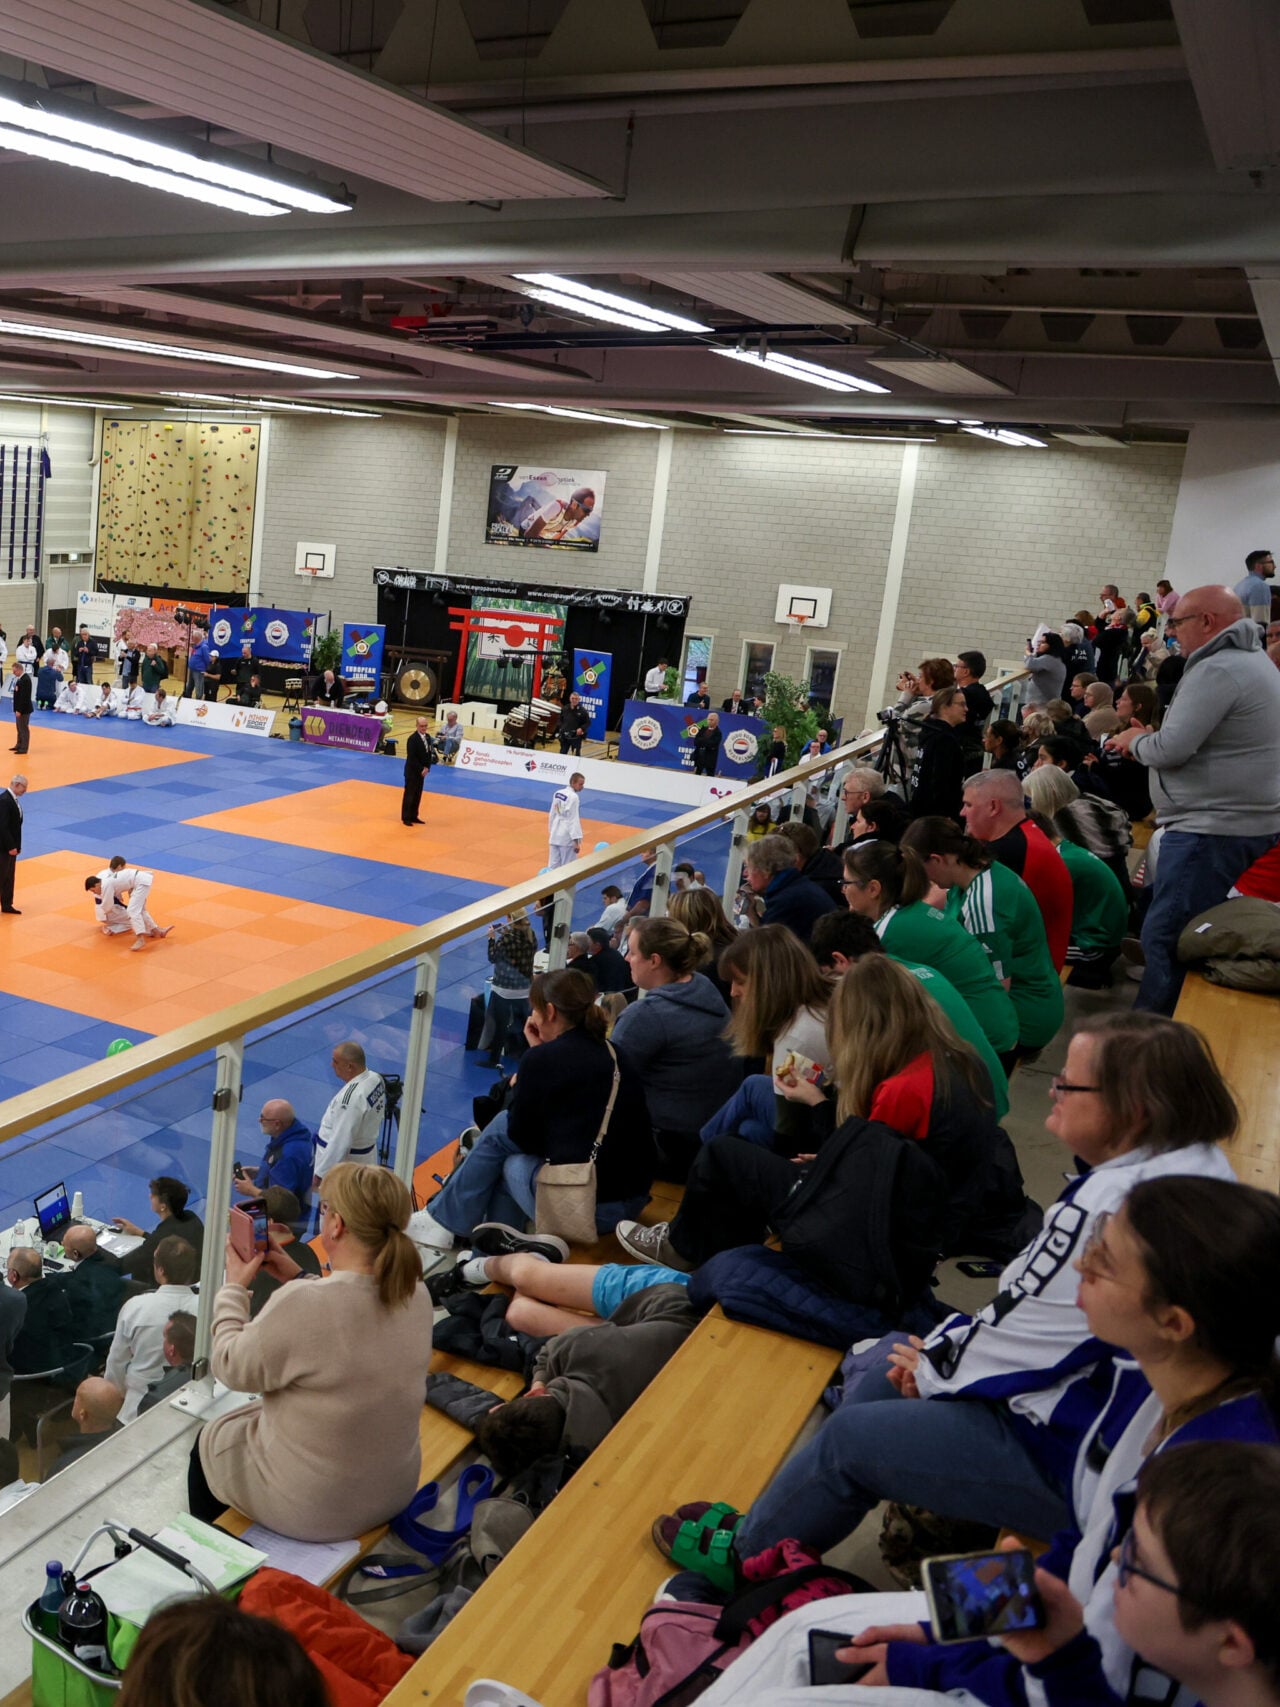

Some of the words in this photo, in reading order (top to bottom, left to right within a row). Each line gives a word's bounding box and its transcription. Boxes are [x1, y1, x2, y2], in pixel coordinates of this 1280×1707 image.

[456, 583, 517, 594] www.europaverhuur.nl
[345, 665, 376, 674] EUROPEAN
[578, 695, 603, 706] UROPEAN
[540, 762, 568, 771] SEACON
